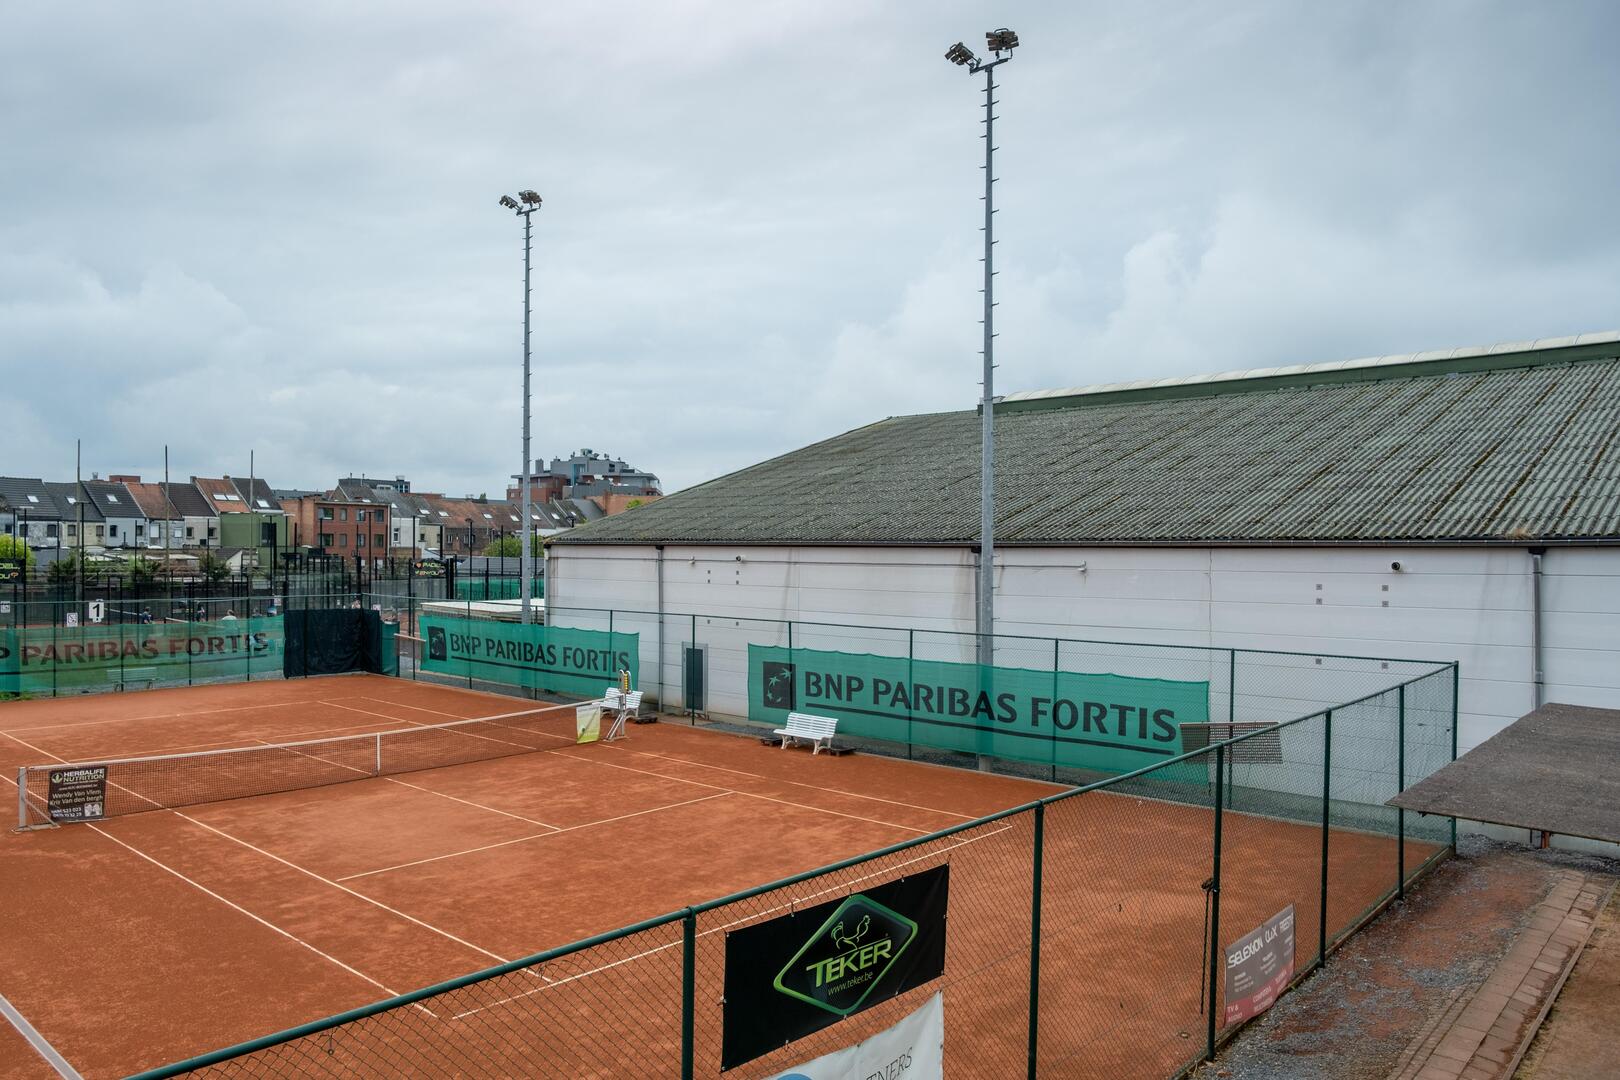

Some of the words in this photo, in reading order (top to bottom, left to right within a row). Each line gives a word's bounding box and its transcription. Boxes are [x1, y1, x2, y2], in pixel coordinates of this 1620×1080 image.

[92, 603, 100, 617] 1
[22, 640, 159, 666] PARIBAS
[168, 633, 269, 658] FORTIS
[450, 633, 482, 655] BNP
[486, 638, 557, 666] PARIBAS
[562, 646, 630, 672] FORTIS
[805, 671, 864, 702] BNP
[872, 677, 1017, 724] PARIBAS
[1031, 697, 1177, 743] FORTIS
[63, 769, 104, 777] HERBALIFE
[63, 774, 104, 783] NUTRITION
[806, 939, 892, 988] TEKER
[828, 971, 874, 996] www.teker.be
